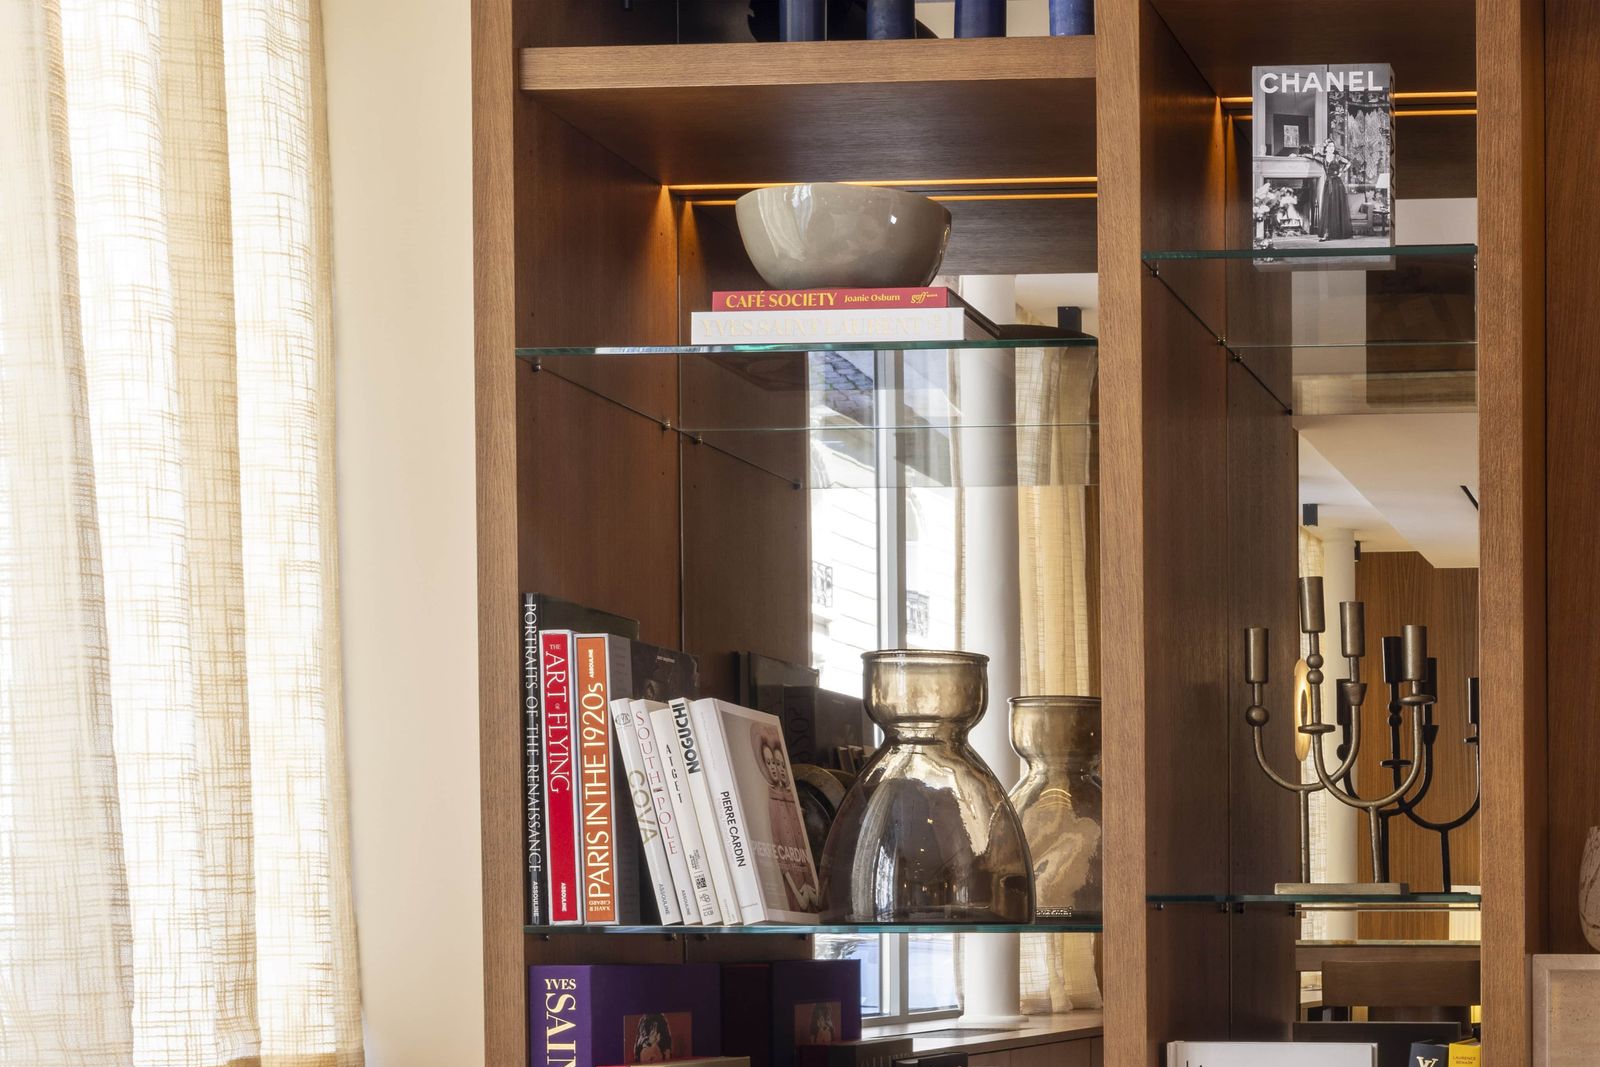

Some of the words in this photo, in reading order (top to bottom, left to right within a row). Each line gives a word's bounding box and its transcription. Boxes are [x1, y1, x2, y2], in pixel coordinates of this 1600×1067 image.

[1259, 71, 1384, 93] CHANEL
[726, 290, 766, 308] CAFÉ
[768, 292, 837, 307] SOCIETY
[844, 294, 869, 303] Joanie
[871, 293, 900, 302] Osburn
[700, 319, 754, 337] YVES
[757, 318, 819, 337] SAINT
[822, 316, 925, 336] LAURENT
[524, 603, 538, 689] PORTRAITS
[545, 651, 567, 703] ART
[525, 696, 539, 717] OF
[582, 682, 606, 749] 1920s
[526, 724, 540, 756] THE
[548, 712, 570, 793] FLYING
[671, 702, 701, 774] NOGUCHI
[583, 754, 607, 800] THE
[635, 711, 661, 785] SOUTH
[653, 797, 678, 855] POLE
[527, 764, 542, 872] RENAISSANCE
[586, 802, 608, 825] IN
[628, 769, 658, 846] COVA
[720, 791, 736, 826] PIERRE
[729, 826, 746, 868] CARDIN
[586, 830, 611, 898] PARIS
[777, 845, 808, 864] CARDIN
[532, 881, 540, 917] ASSOULINE
[658, 883, 671, 916] ASSOULINE
[681, 889, 692, 916] ASSOULINE
[544, 978, 577, 990] YVES
